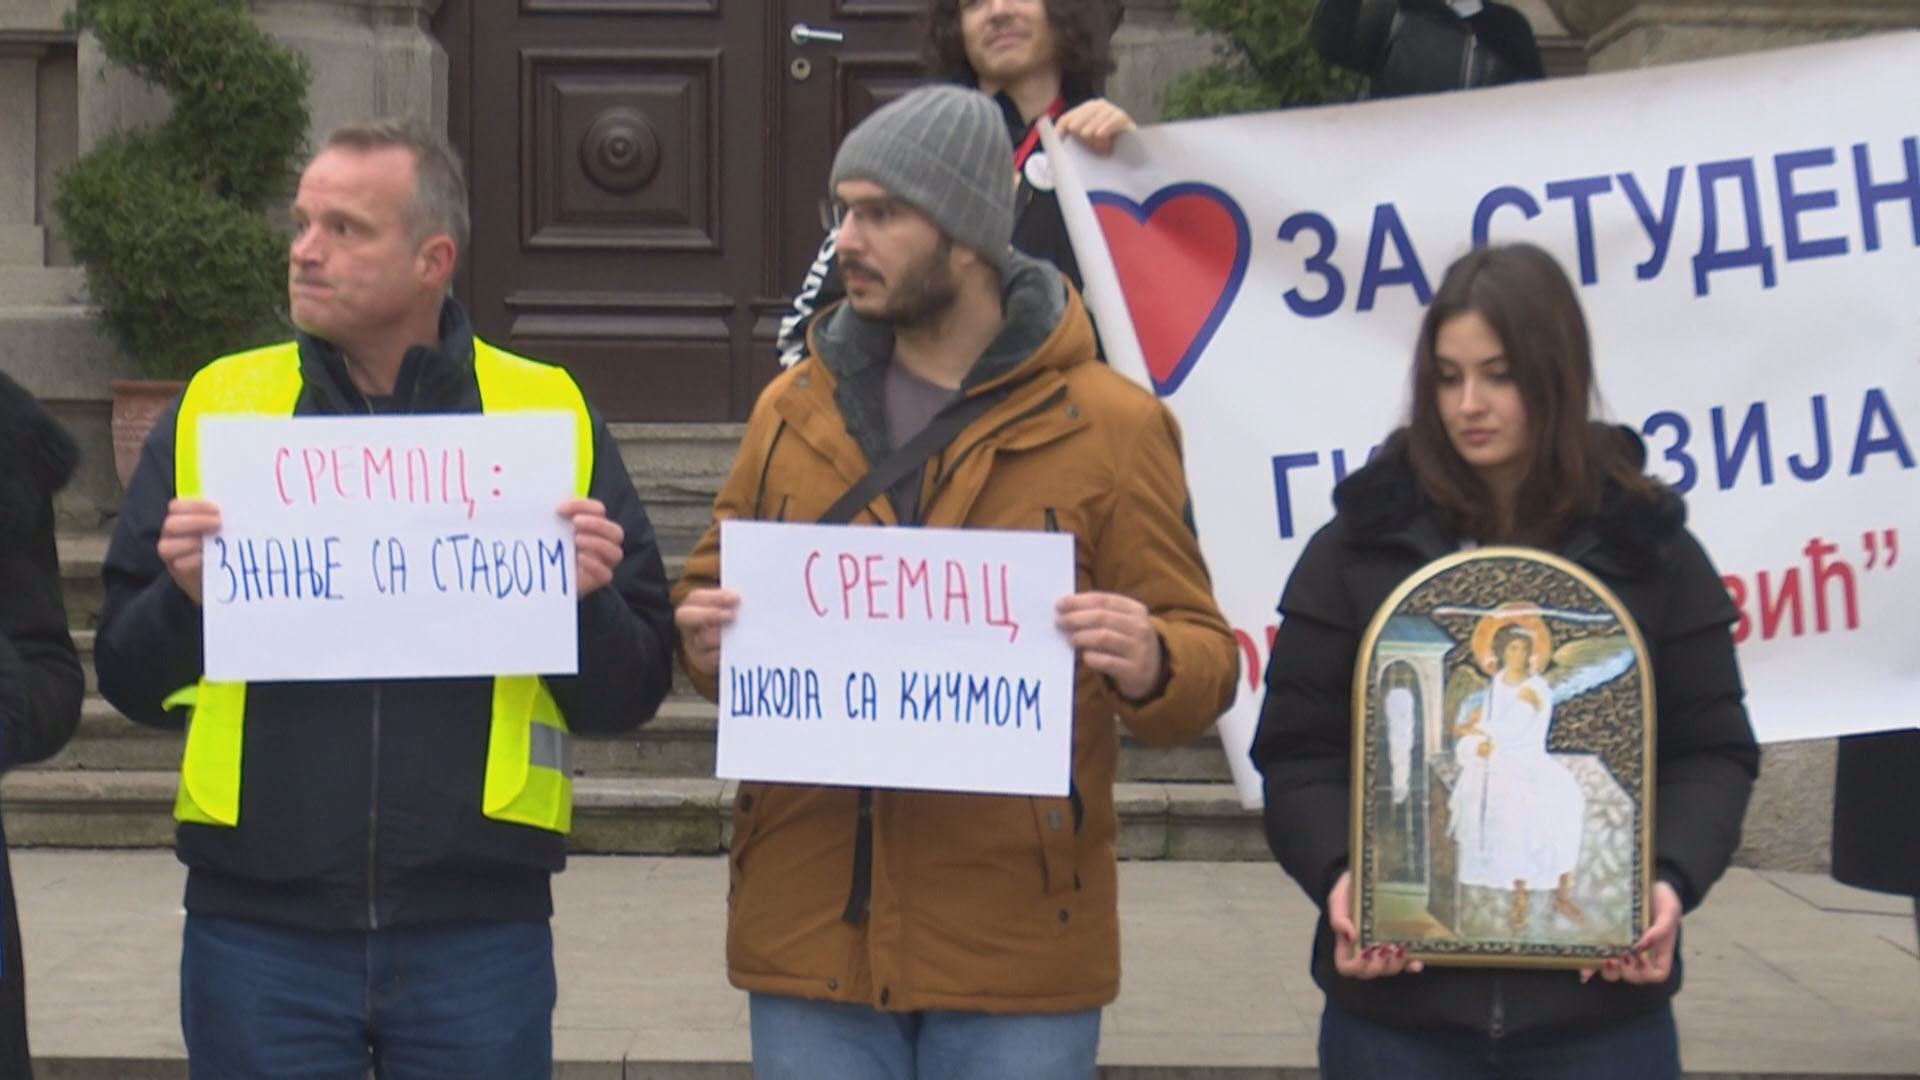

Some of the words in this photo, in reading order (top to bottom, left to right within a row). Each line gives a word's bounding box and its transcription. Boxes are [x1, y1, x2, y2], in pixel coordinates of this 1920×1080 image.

[1277, 203, 1434, 318] ЗА
[274, 446, 502, 520] СРЕМАЦ:
[214, 535, 344, 604] ЗНАЊЕ
[372, 536, 407, 595] СА
[432, 533, 568, 600] СТАВОМ
[804, 550, 1019, 644] СРЕМАЦ
[730, 665, 822, 720] ШКОЛА
[846, 671, 877, 721] СА
[900, 670, 1042, 732] КИЧМОМ
